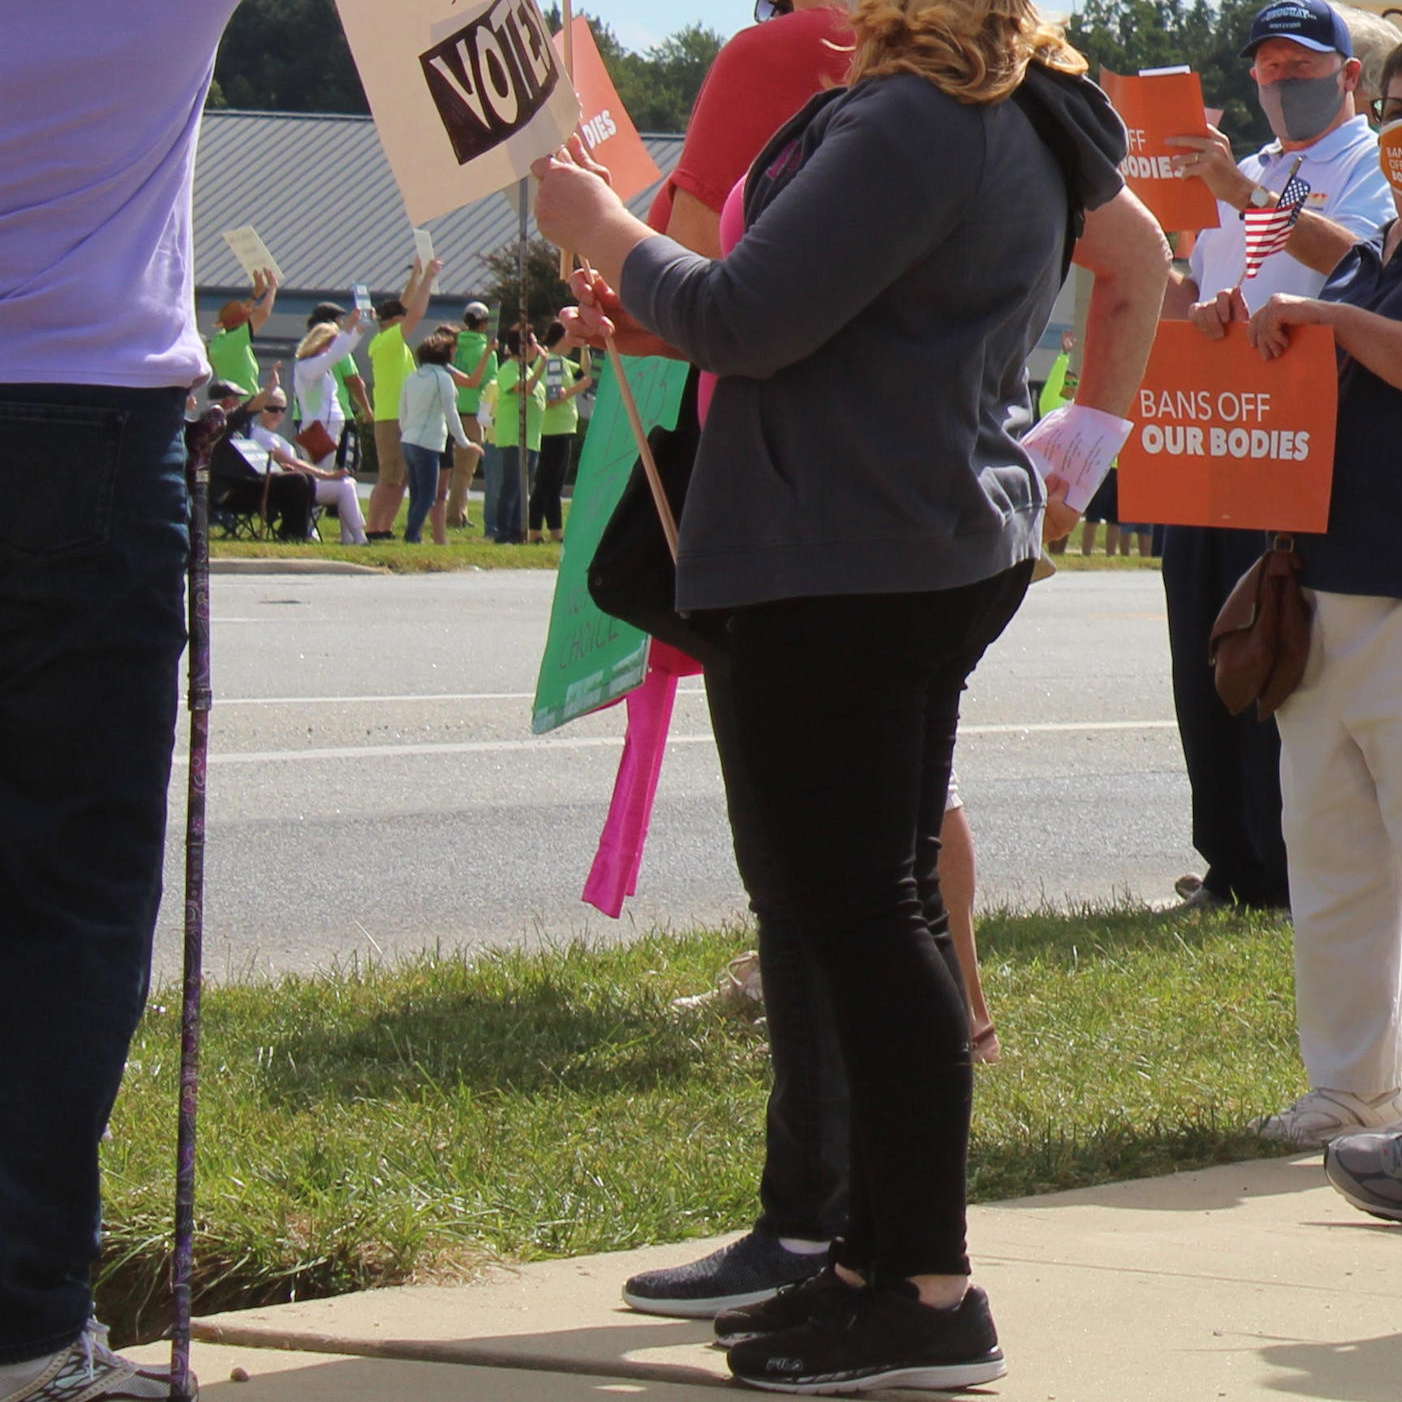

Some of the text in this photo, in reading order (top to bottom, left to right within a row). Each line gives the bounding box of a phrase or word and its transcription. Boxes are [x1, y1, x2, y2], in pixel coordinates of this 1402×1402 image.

[1140, 389, 1271, 423] BANS OFF
[1141, 424, 1311, 462] OUR BODIES
